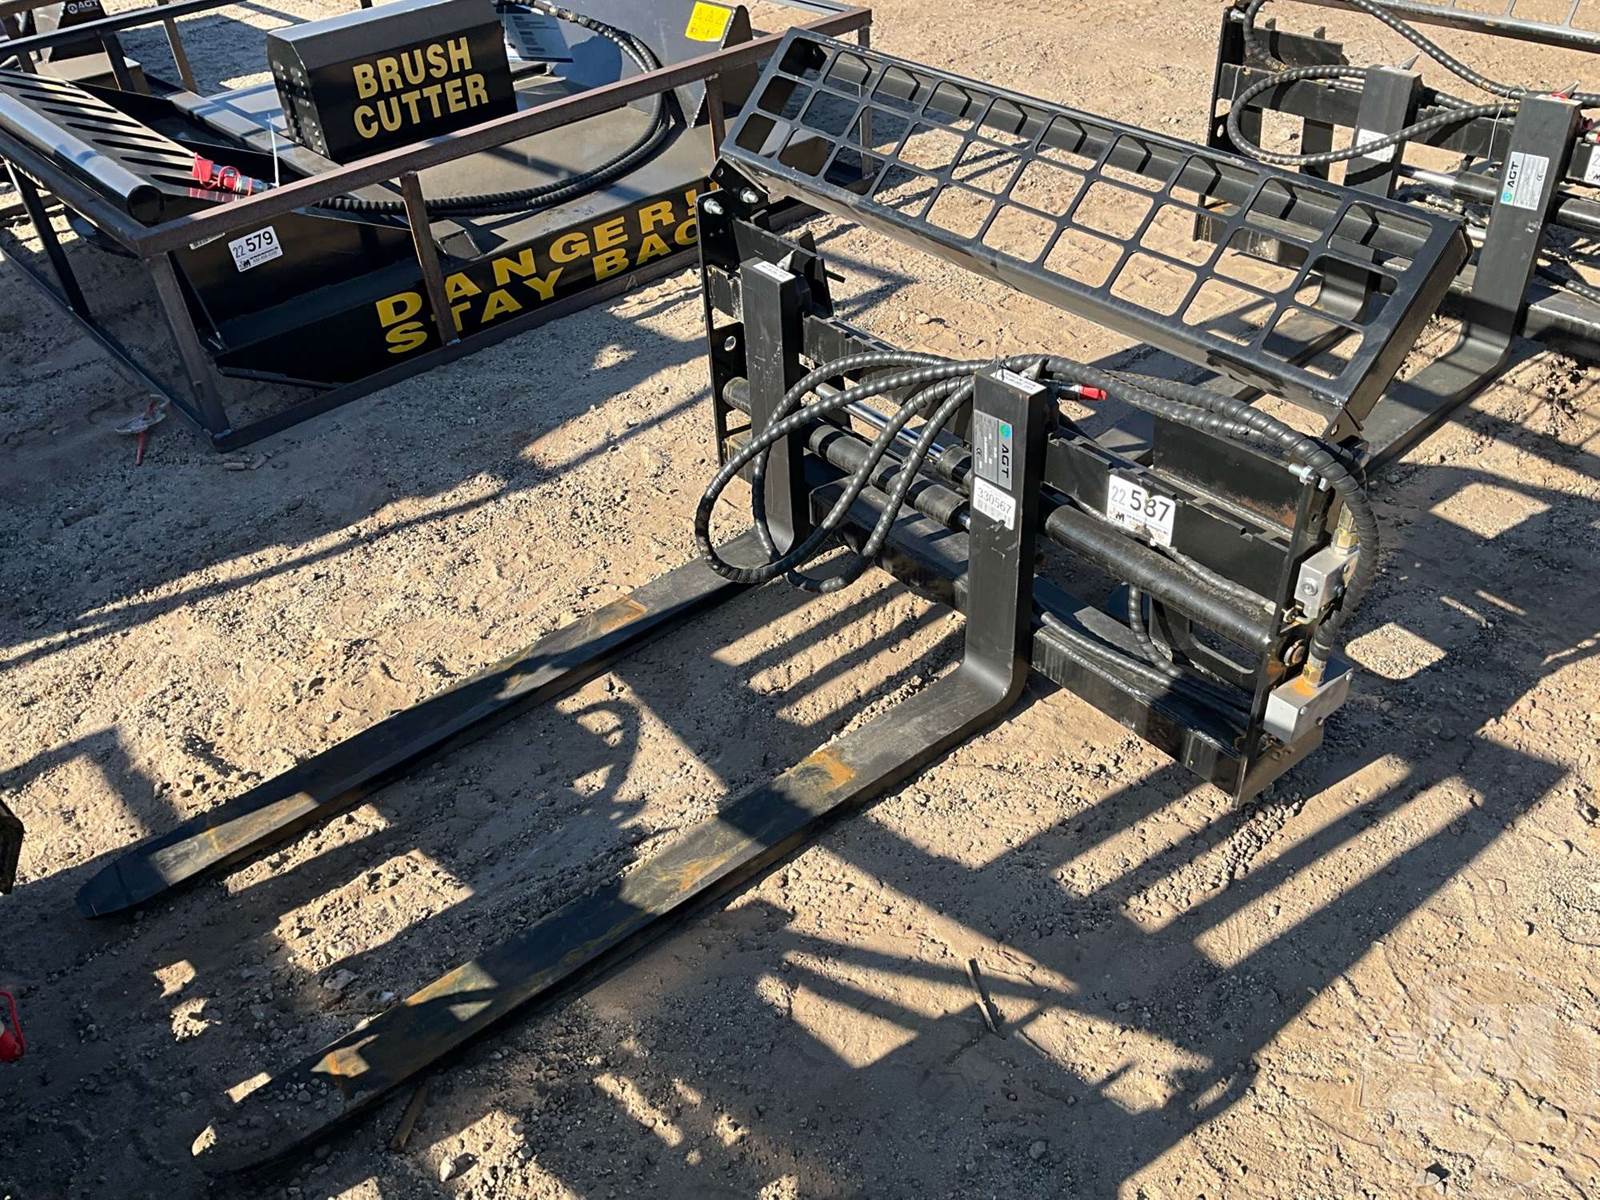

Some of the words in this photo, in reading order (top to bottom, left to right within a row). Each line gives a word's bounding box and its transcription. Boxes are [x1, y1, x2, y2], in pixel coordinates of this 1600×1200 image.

[353, 37, 472, 99] BRUSH
[354, 74, 489, 138] CUTTER
[1507, 161, 1519, 188] AGT
[233, 245, 246, 258] 22
[246, 231, 273, 252] 579
[385, 267, 564, 353] STAY
[593, 218, 697, 281] BAC
[1001, 444, 1010, 479] AGT
[977, 487, 1012, 514] 330567
[1112, 485, 1126, 506] 22
[1130, 490, 1170, 521] 587
